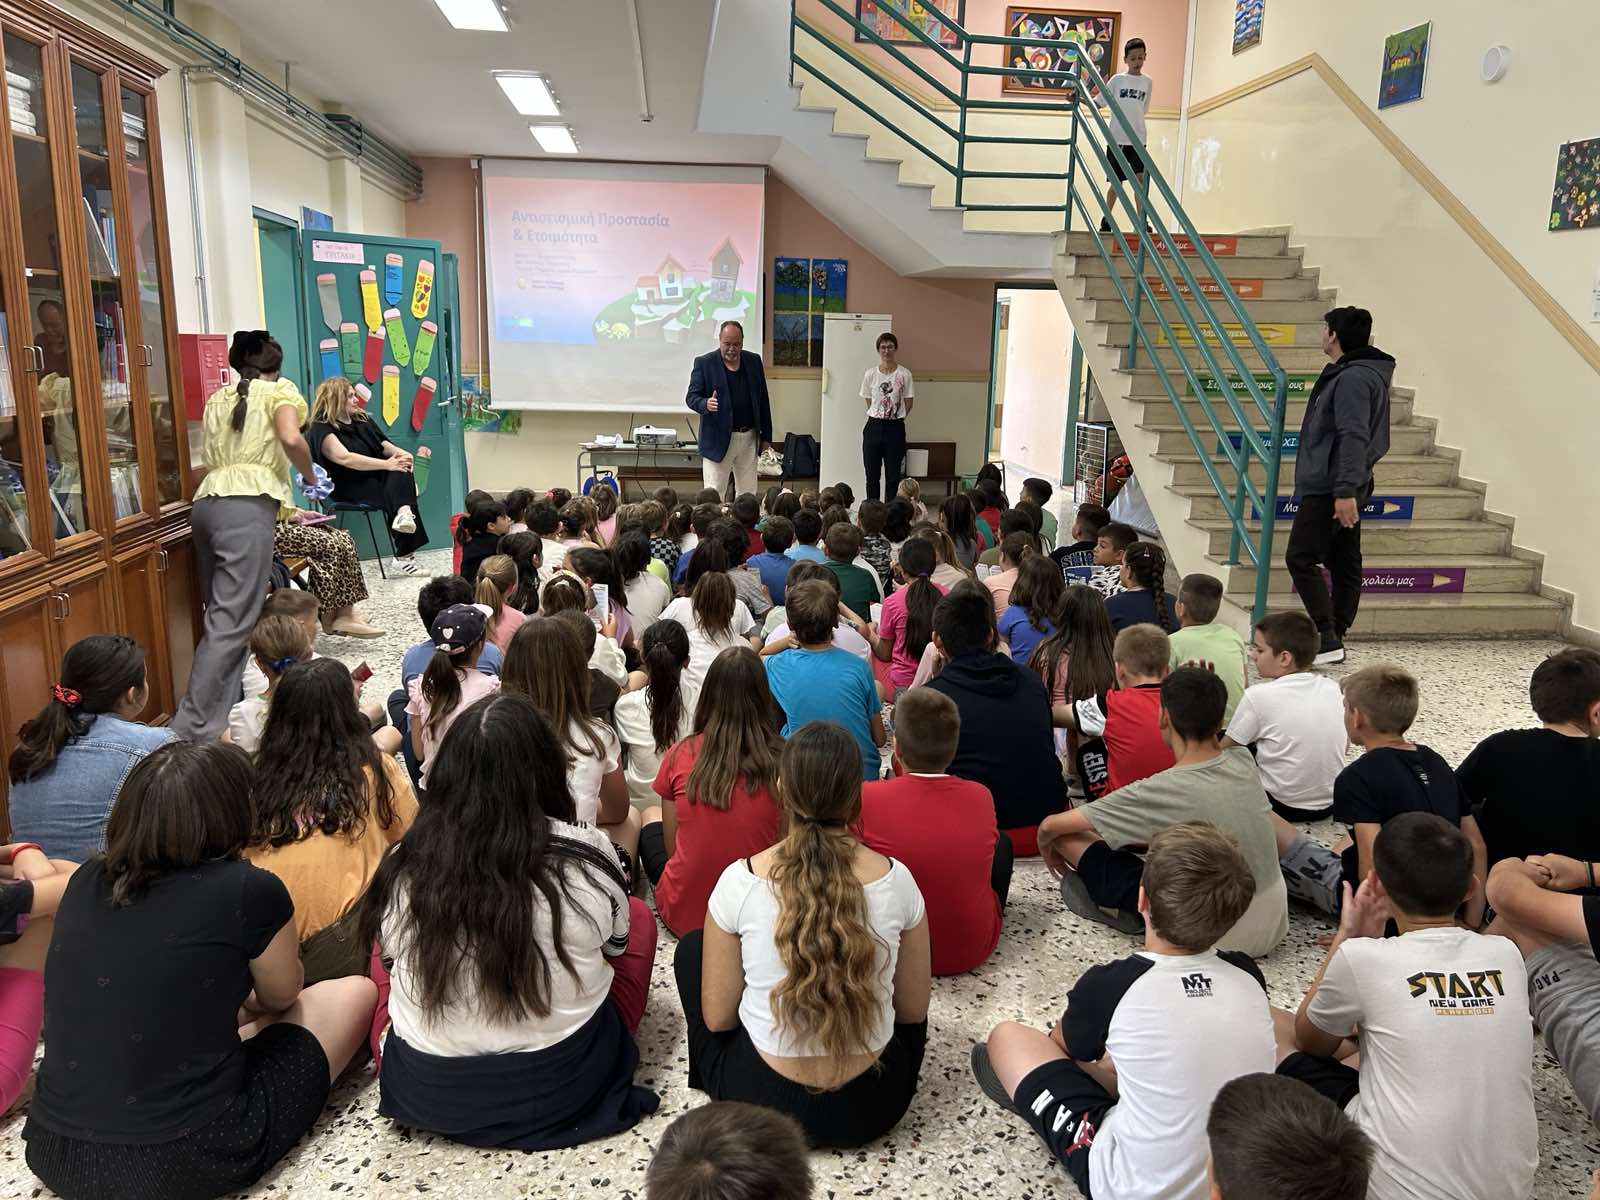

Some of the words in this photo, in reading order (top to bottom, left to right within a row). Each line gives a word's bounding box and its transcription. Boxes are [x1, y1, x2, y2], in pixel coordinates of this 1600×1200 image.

[599, 212, 670, 228] Προστασία
[513, 228, 523, 241] &
[527, 229, 600, 246] Ετοιμότητα
[1361, 575, 1394, 586] χολείο
[1397, 577, 1415, 586] μας
[1406, 969, 1505, 998] START
[1429, 999, 1457, 1008] NEW
[1462, 998, 1495, 1008] GAME
